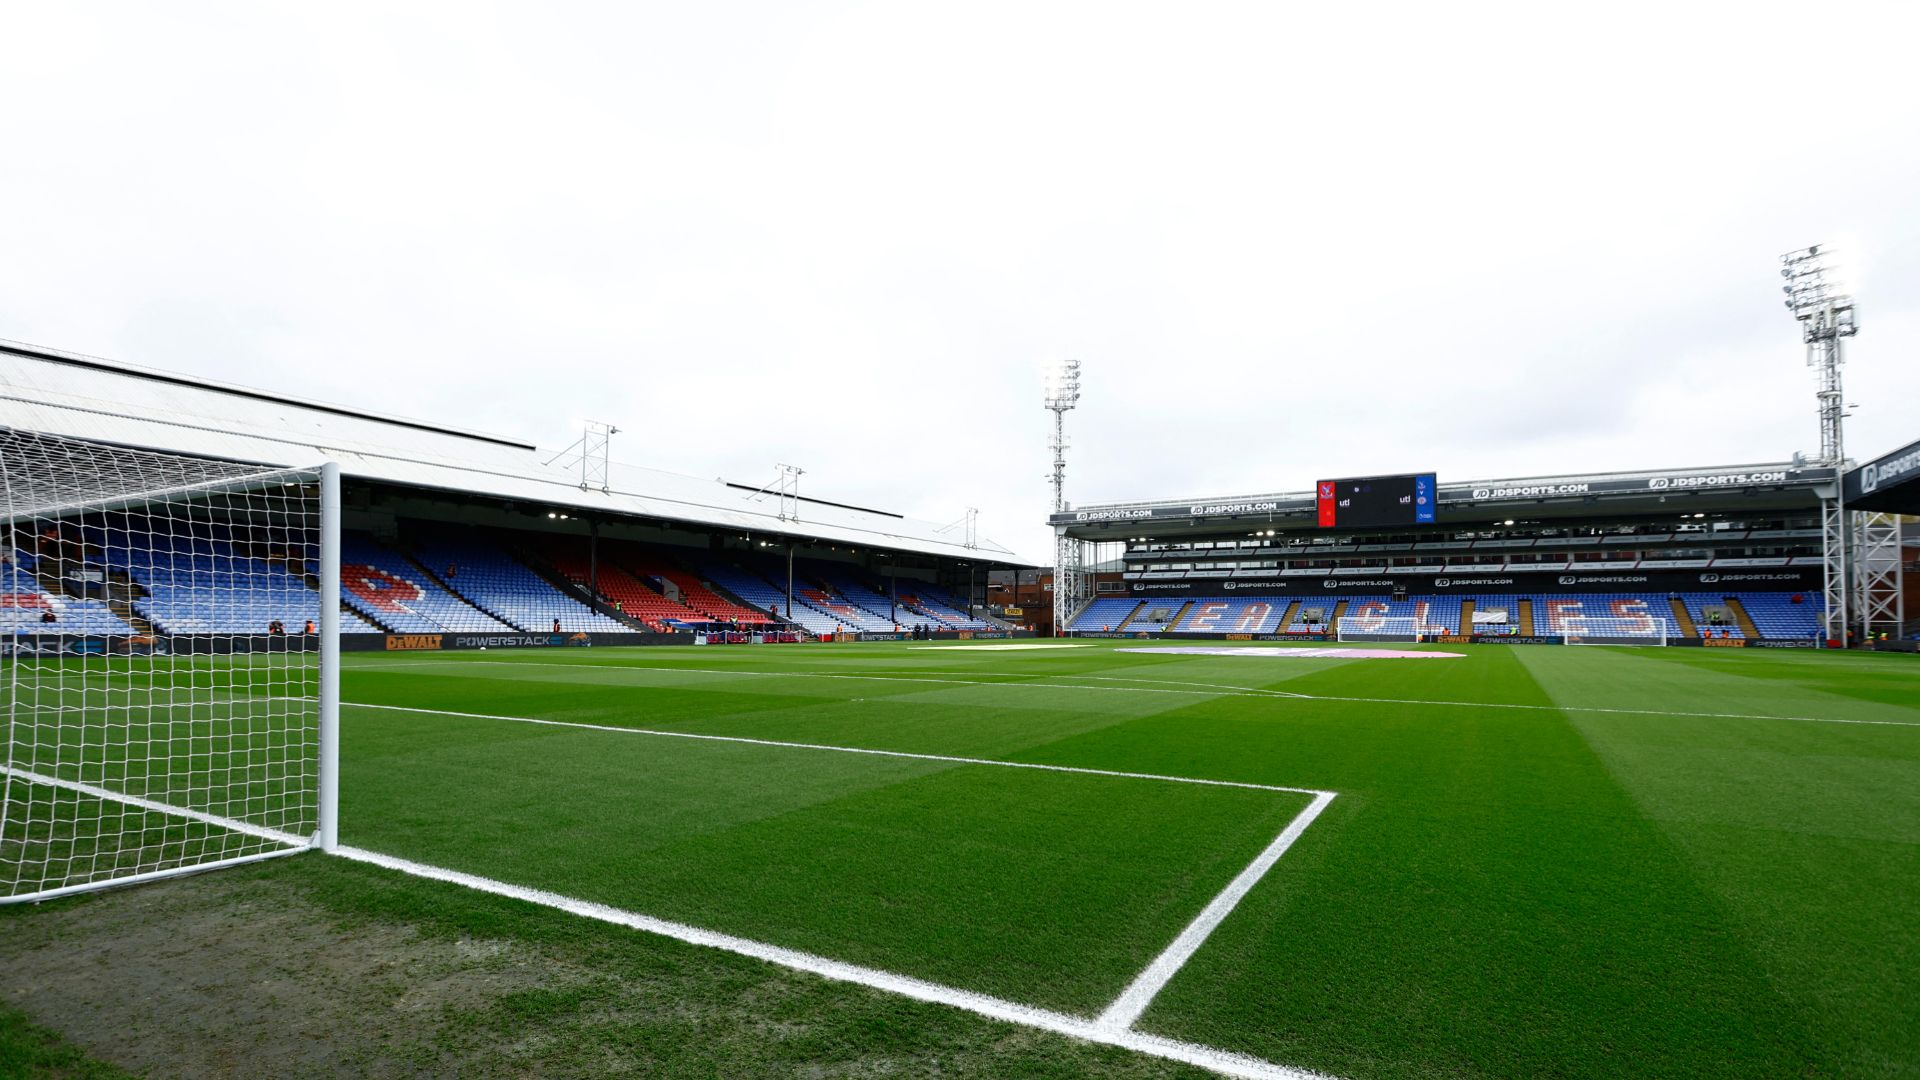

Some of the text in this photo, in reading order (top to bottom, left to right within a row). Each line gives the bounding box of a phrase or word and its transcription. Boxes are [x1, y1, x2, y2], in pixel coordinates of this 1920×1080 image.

[1648, 472, 1786, 489] JD JDSPORTS.COM
[1473, 484, 1589, 499] JD JDSPORTS.COM
[1089, 509, 1152, 519] JDSPORTS.COM
[1190, 502, 1277, 515] JD JDSPORTS.COM
[1451, 578, 1513, 586] JDSPORTS.COM
[1721, 573, 1801, 581] JDSPORTS.COM
[456, 636, 550, 647] POWERSTACK
